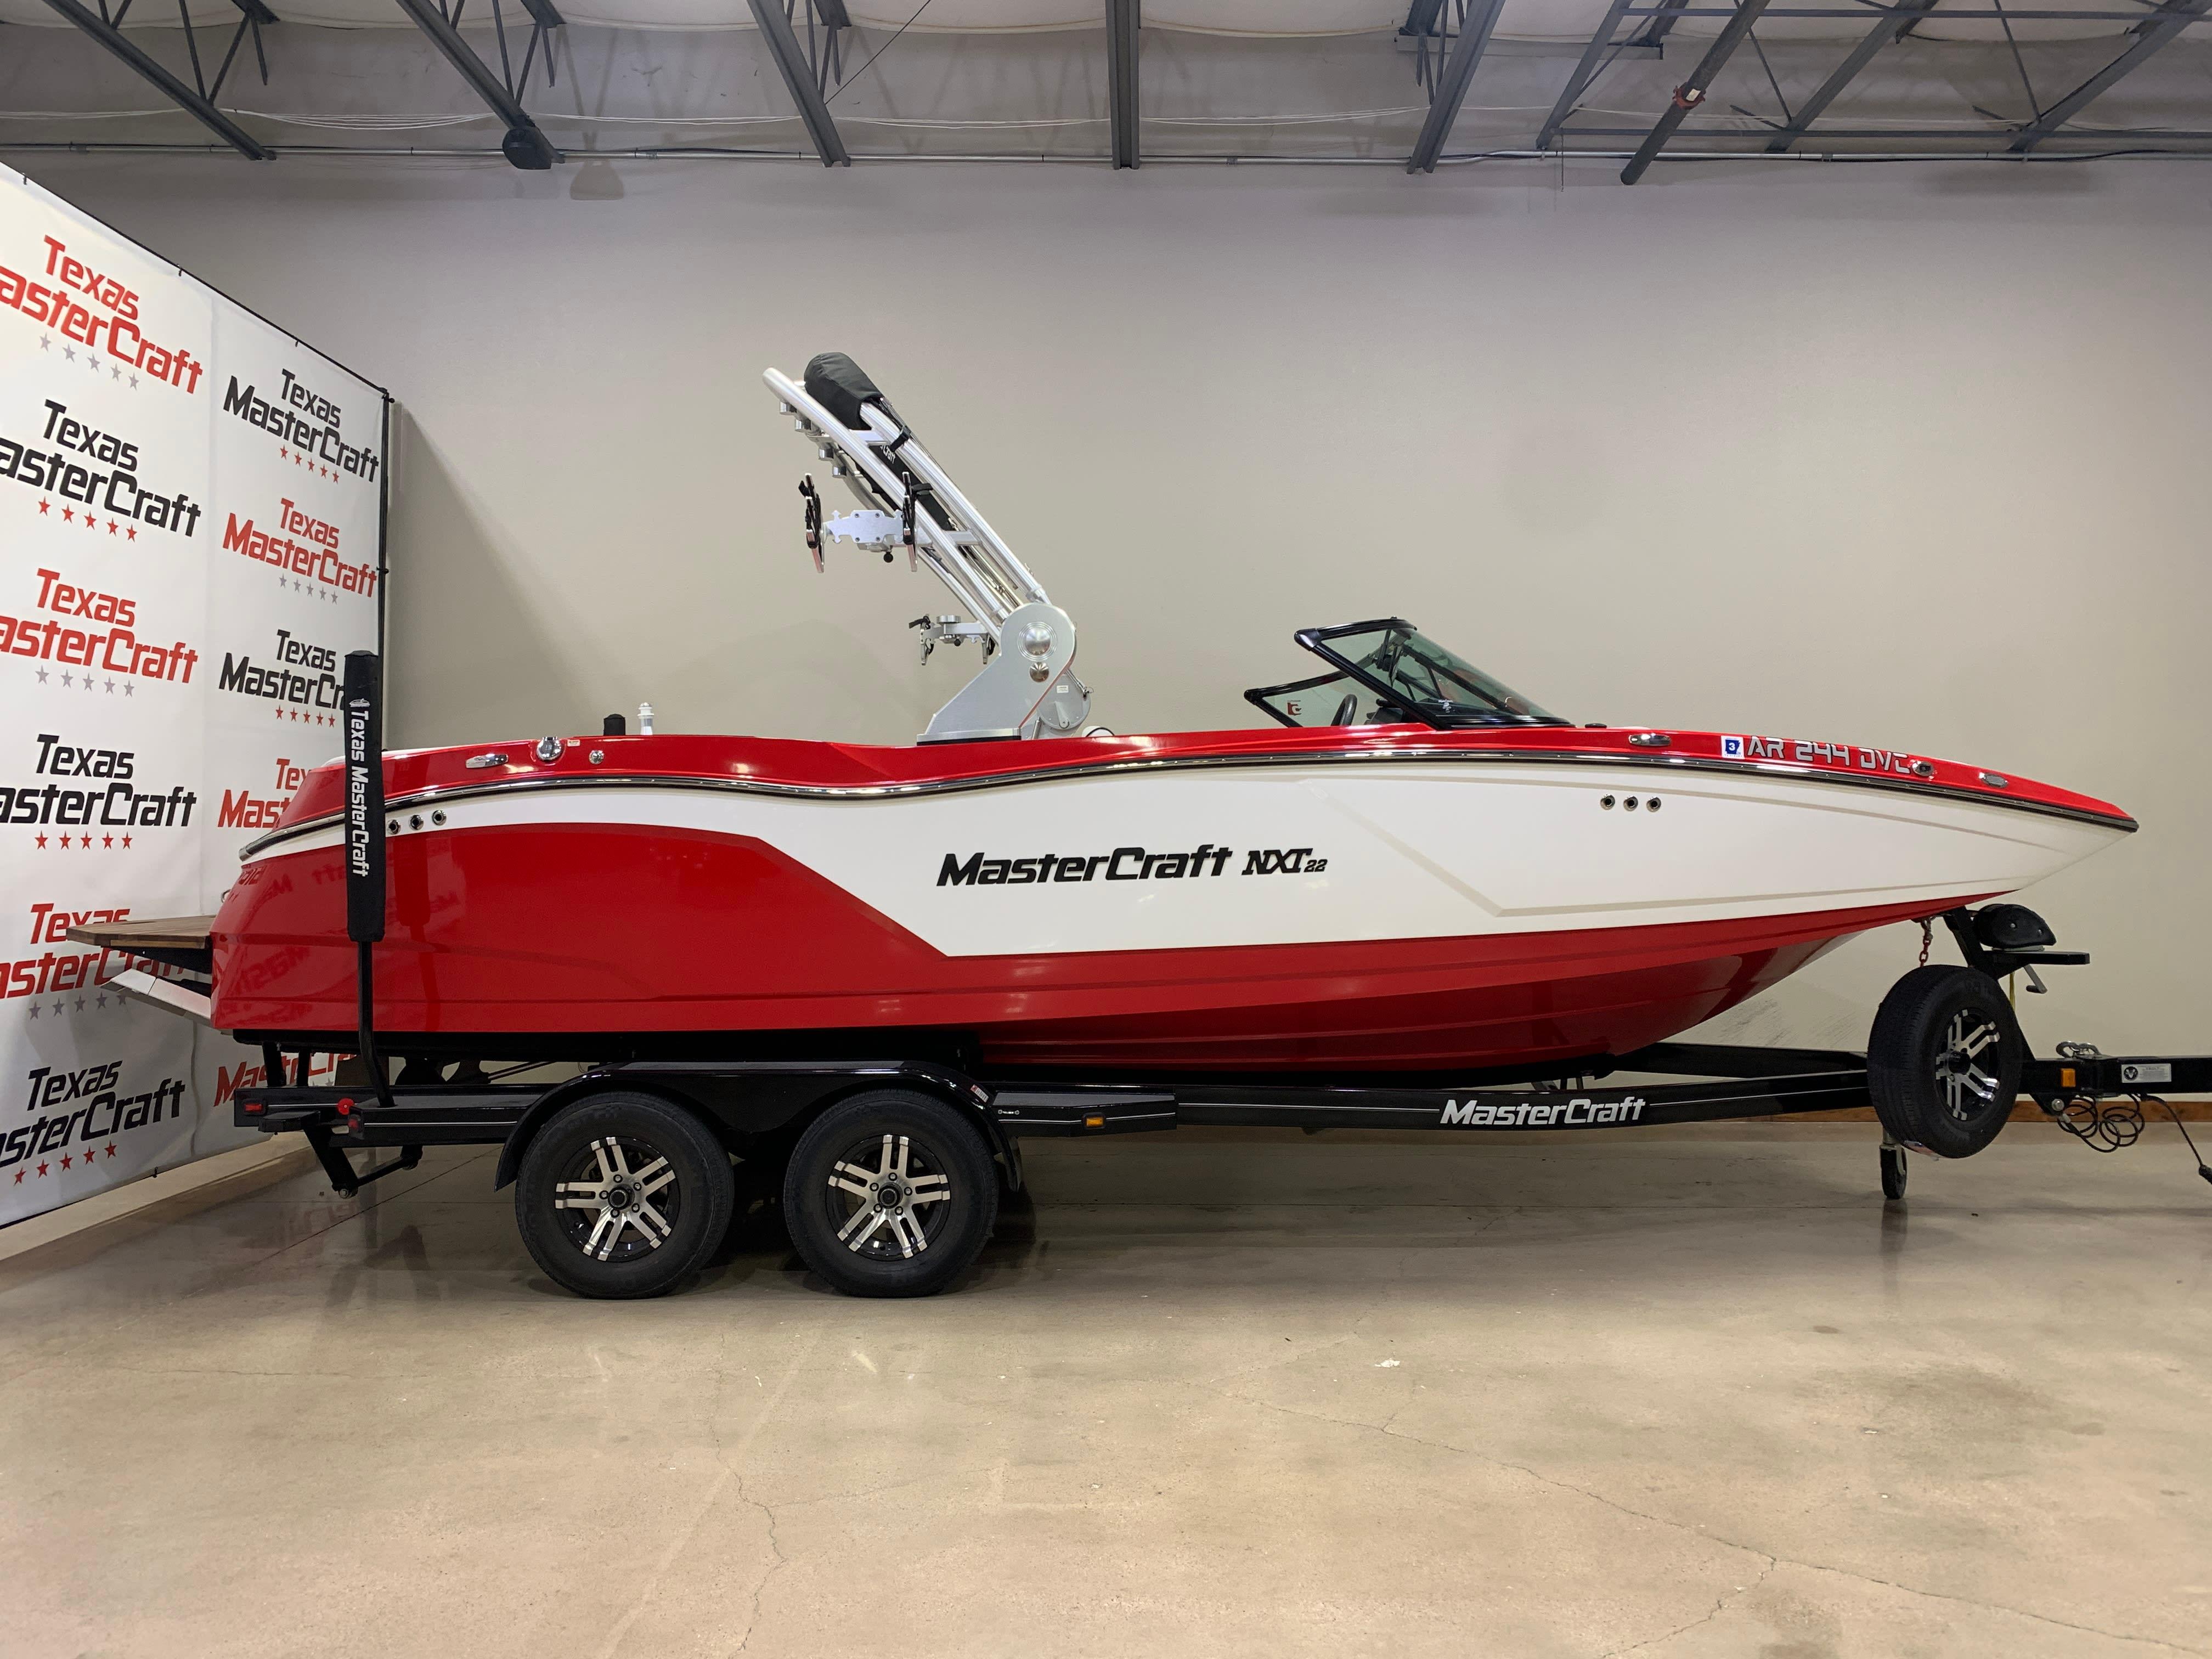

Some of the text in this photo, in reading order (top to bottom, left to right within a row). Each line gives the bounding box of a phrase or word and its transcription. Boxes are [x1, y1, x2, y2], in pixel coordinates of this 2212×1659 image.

[45, 235, 139, 320] Texas
[0, 266, 202, 393] asterCraft
[281, 369, 341, 428] Texas
[43, 399, 139, 472] Texas
[223, 375, 379, 483] MasterCraft
[0, 437, 201, 537] asterCraft
[280, 498, 339, 549] Texas
[223, 513, 377, 597] MasterCraft
[37, 568, 136, 627] Texas
[0, 616, 198, 684] asterCraft
[276, 629, 336, 672] Texas
[36, 733, 134, 780] Texas
[1747, 736, 1784, 759] AR
[1793, 740, 1850, 766] 244
[0, 782, 197, 827] asterCraft
[351, 710, 370, 877] Texas MasterCraft
[936, 844, 1233, 887] MasterCraft
[27, 1059, 123, 1111] Texas
[1440, 1096, 1646, 1125] MasterCraft
